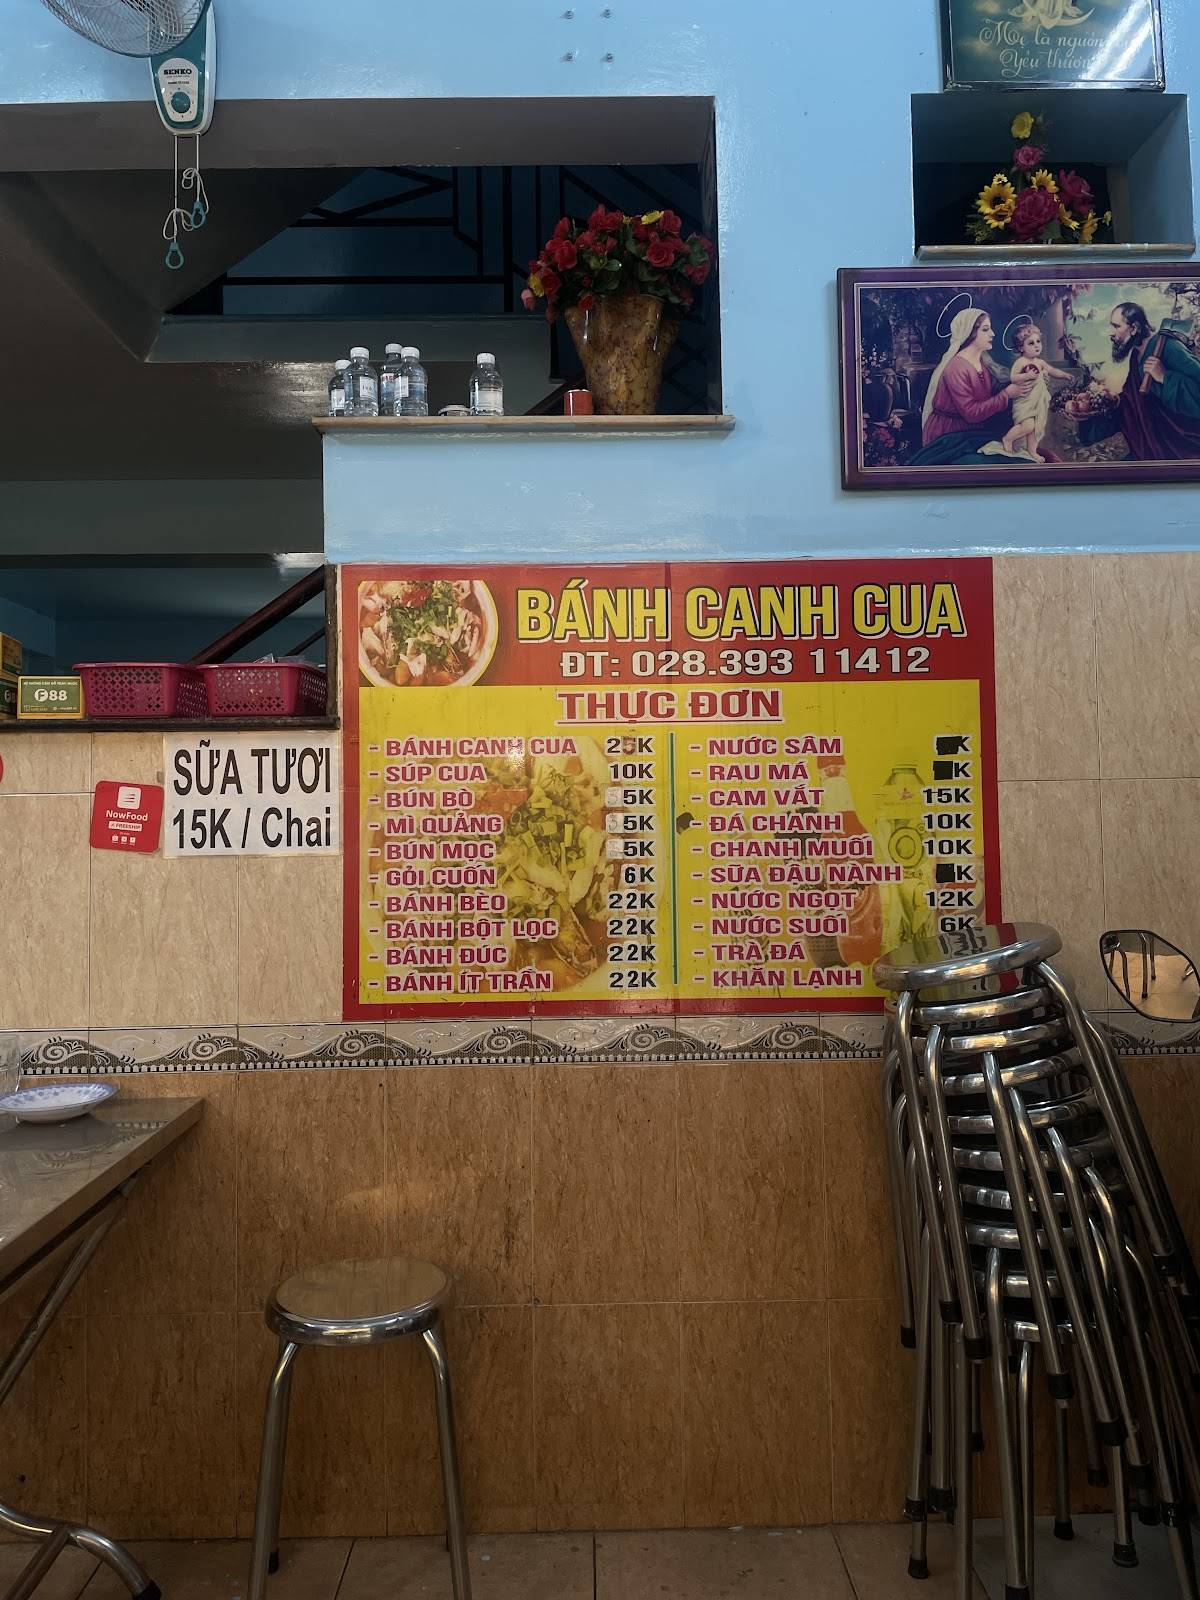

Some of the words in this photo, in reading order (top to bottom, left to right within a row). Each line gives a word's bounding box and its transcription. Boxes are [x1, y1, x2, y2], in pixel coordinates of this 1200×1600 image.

[517, 577, 670, 643] BÁNH
[685, 584, 838, 642] CANH
[853, 582, 968, 640] CUA
[560, 650, 619, 678] ĐT:
[632, 648, 793, 677] 028.393
[34, 688, 68, 702] F88
[557, 687, 676, 724] THỰC
[688, 688, 781, 719] ĐƠN
[386, 738, 451, 755] BÁNH
[459, 738, 524, 755] CANH
[530, 738, 577, 755] CUA
[709, 736, 777, 755] NƯỚC
[785, 735, 841, 754] SÂM
[173, 739, 243, 796] SỮA
[250, 747, 331, 794] TƯƠI
[386, 763, 432, 781] SÚP
[438, 765, 486, 781] CUA
[610, 763, 653, 778] 10K
[710, 764, 760, 781] RAU
[768, 761, 809, 780] MÁ
[386, 790, 434, 808] BÚN
[442, 789, 473, 807] BÒ
[710, 789, 765, 806] CAM
[774, 784, 824, 805] VẮT
[923, 787, 971, 804] 15K
[106, 810, 148, 821] NowFood
[387, 815, 414, 834] MÌ
[422, 812, 502, 834] QUẢNG
[709, 812, 745, 832] ĐÁ
[752, 815, 841, 831] CHANH
[924, 813, 972, 829] 10K
[172, 807, 232, 849] 15K
[241, 807, 251, 848] /
[261, 806, 331, 848] Chai
[387, 841, 434, 859] BÚN
[443, 842, 494, 862] MỌC
[710, 840, 799, 857] CHANH
[808, 836, 873, 856] MUỐI
[924, 839, 973, 855] 10K
[386, 867, 424, 885] GỎI
[432, 863, 495, 885] CUỐN
[624, 866, 655, 883] 6K
[711, 863, 761, 883] SỮA
[769, 863, 821, 885] ĐẬU
[829, 863, 901, 882] NÀNH
[386, 893, 452, 912] BÁNH
[460, 892, 506, 911] BÈO
[608, 893, 656, 909] 22K
[712, 890, 779, 909] NƯỚC
[788, 891, 856, 911] NGỌT
[926, 891, 974, 906] 12K
[386, 920, 452, 938] BÁNH
[460, 919, 505, 941] BỘT
[513, 920, 557, 942] LỌC
[608, 919, 656, 936] 22K
[712, 916, 780, 935] NƯỚC
[788, 913, 847, 934] SUỐI
[940, 917, 975, 933] 6K
[386, 945, 452, 965] BÁNH
[459, 945, 507, 964] ĐÚC
[608, 945, 656, 962] 22K
[712, 942, 763, 961] TRÀ
[769, 941, 805, 960] ĐÁ
[386, 973, 452, 992] BÁNH
[460, 970, 482, 990] ÍT
[609, 971, 656, 988] 22K
[713, 967, 788, 987] KHĂN
[794, 969, 862, 988] LẠNH
